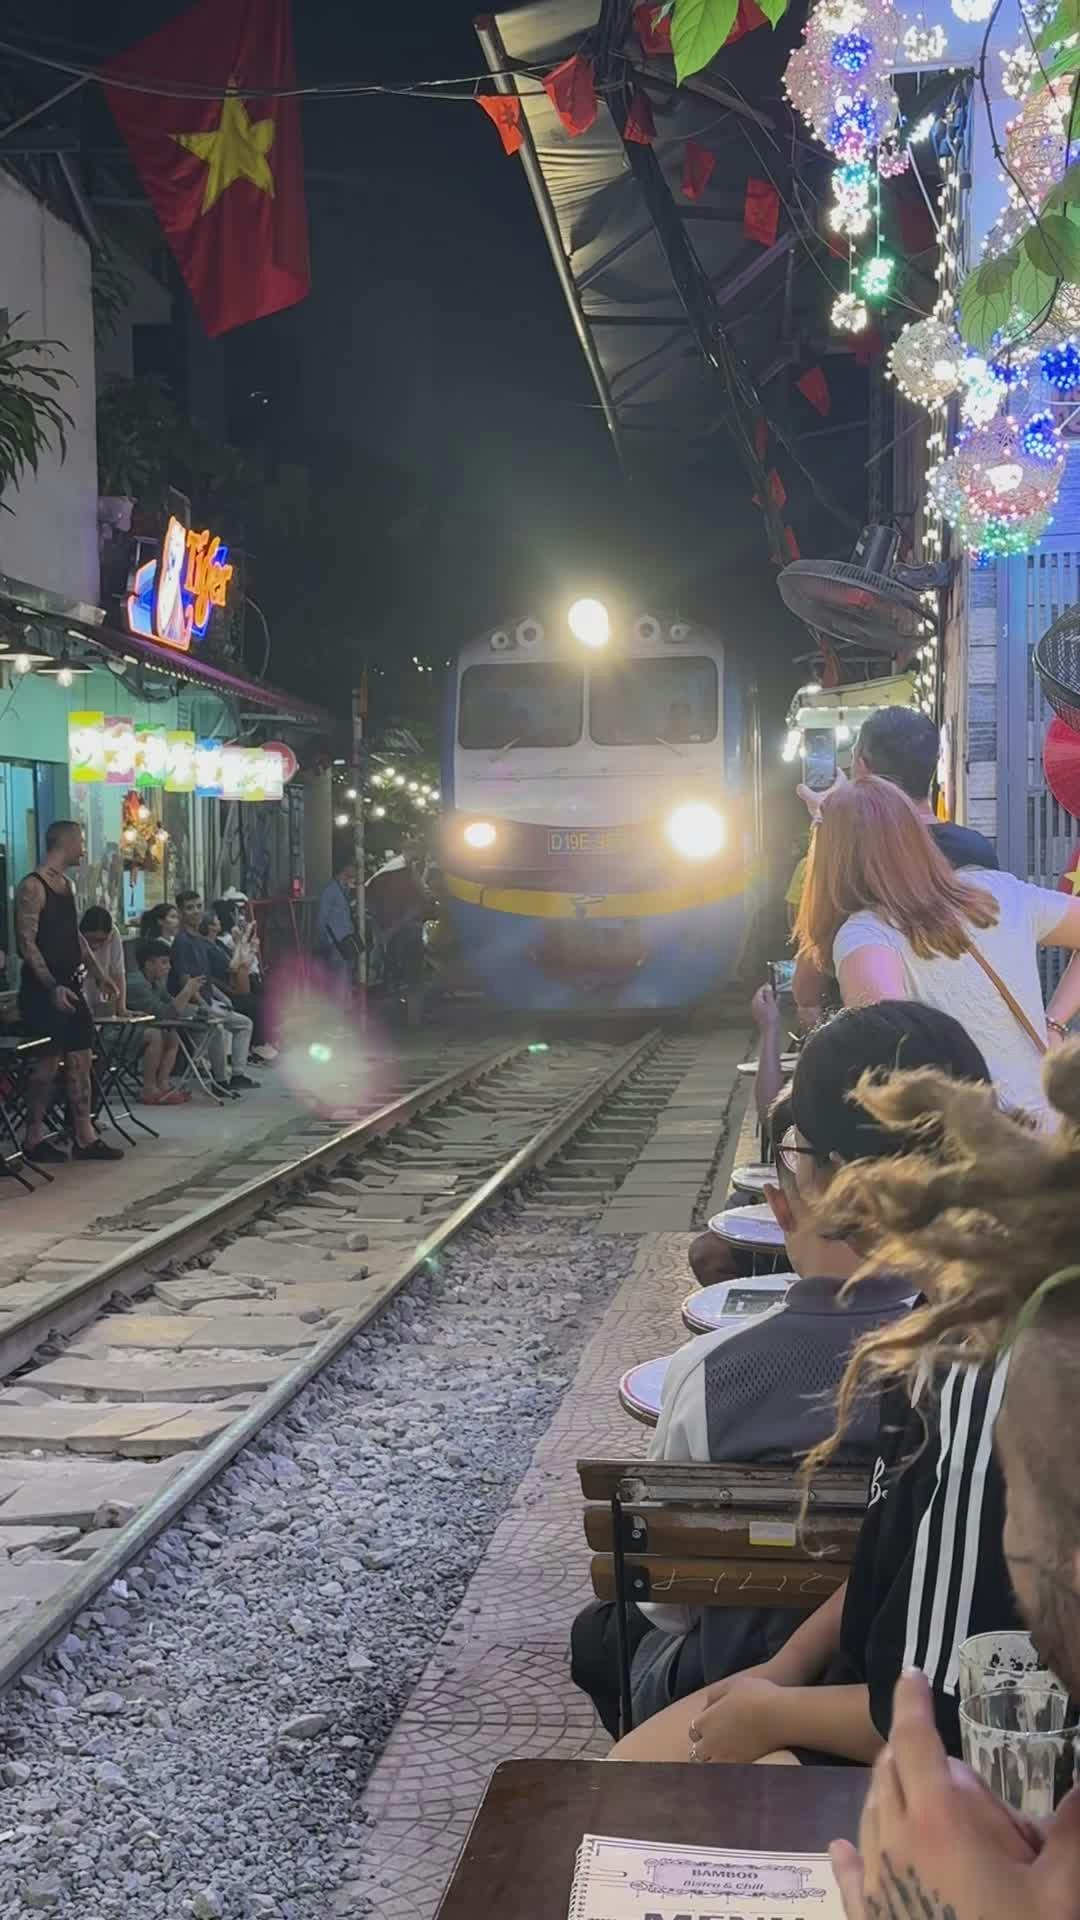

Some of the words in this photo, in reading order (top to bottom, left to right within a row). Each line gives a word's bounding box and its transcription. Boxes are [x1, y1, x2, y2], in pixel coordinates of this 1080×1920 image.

[184, 530, 233, 628] Tiger
[692, 1869, 759, 1880] BAMBOO
[683, 1880, 721, 1889] Bistro
[723, 1882, 733, 1890] &
[735, 1883, 765, 1891] Chill
